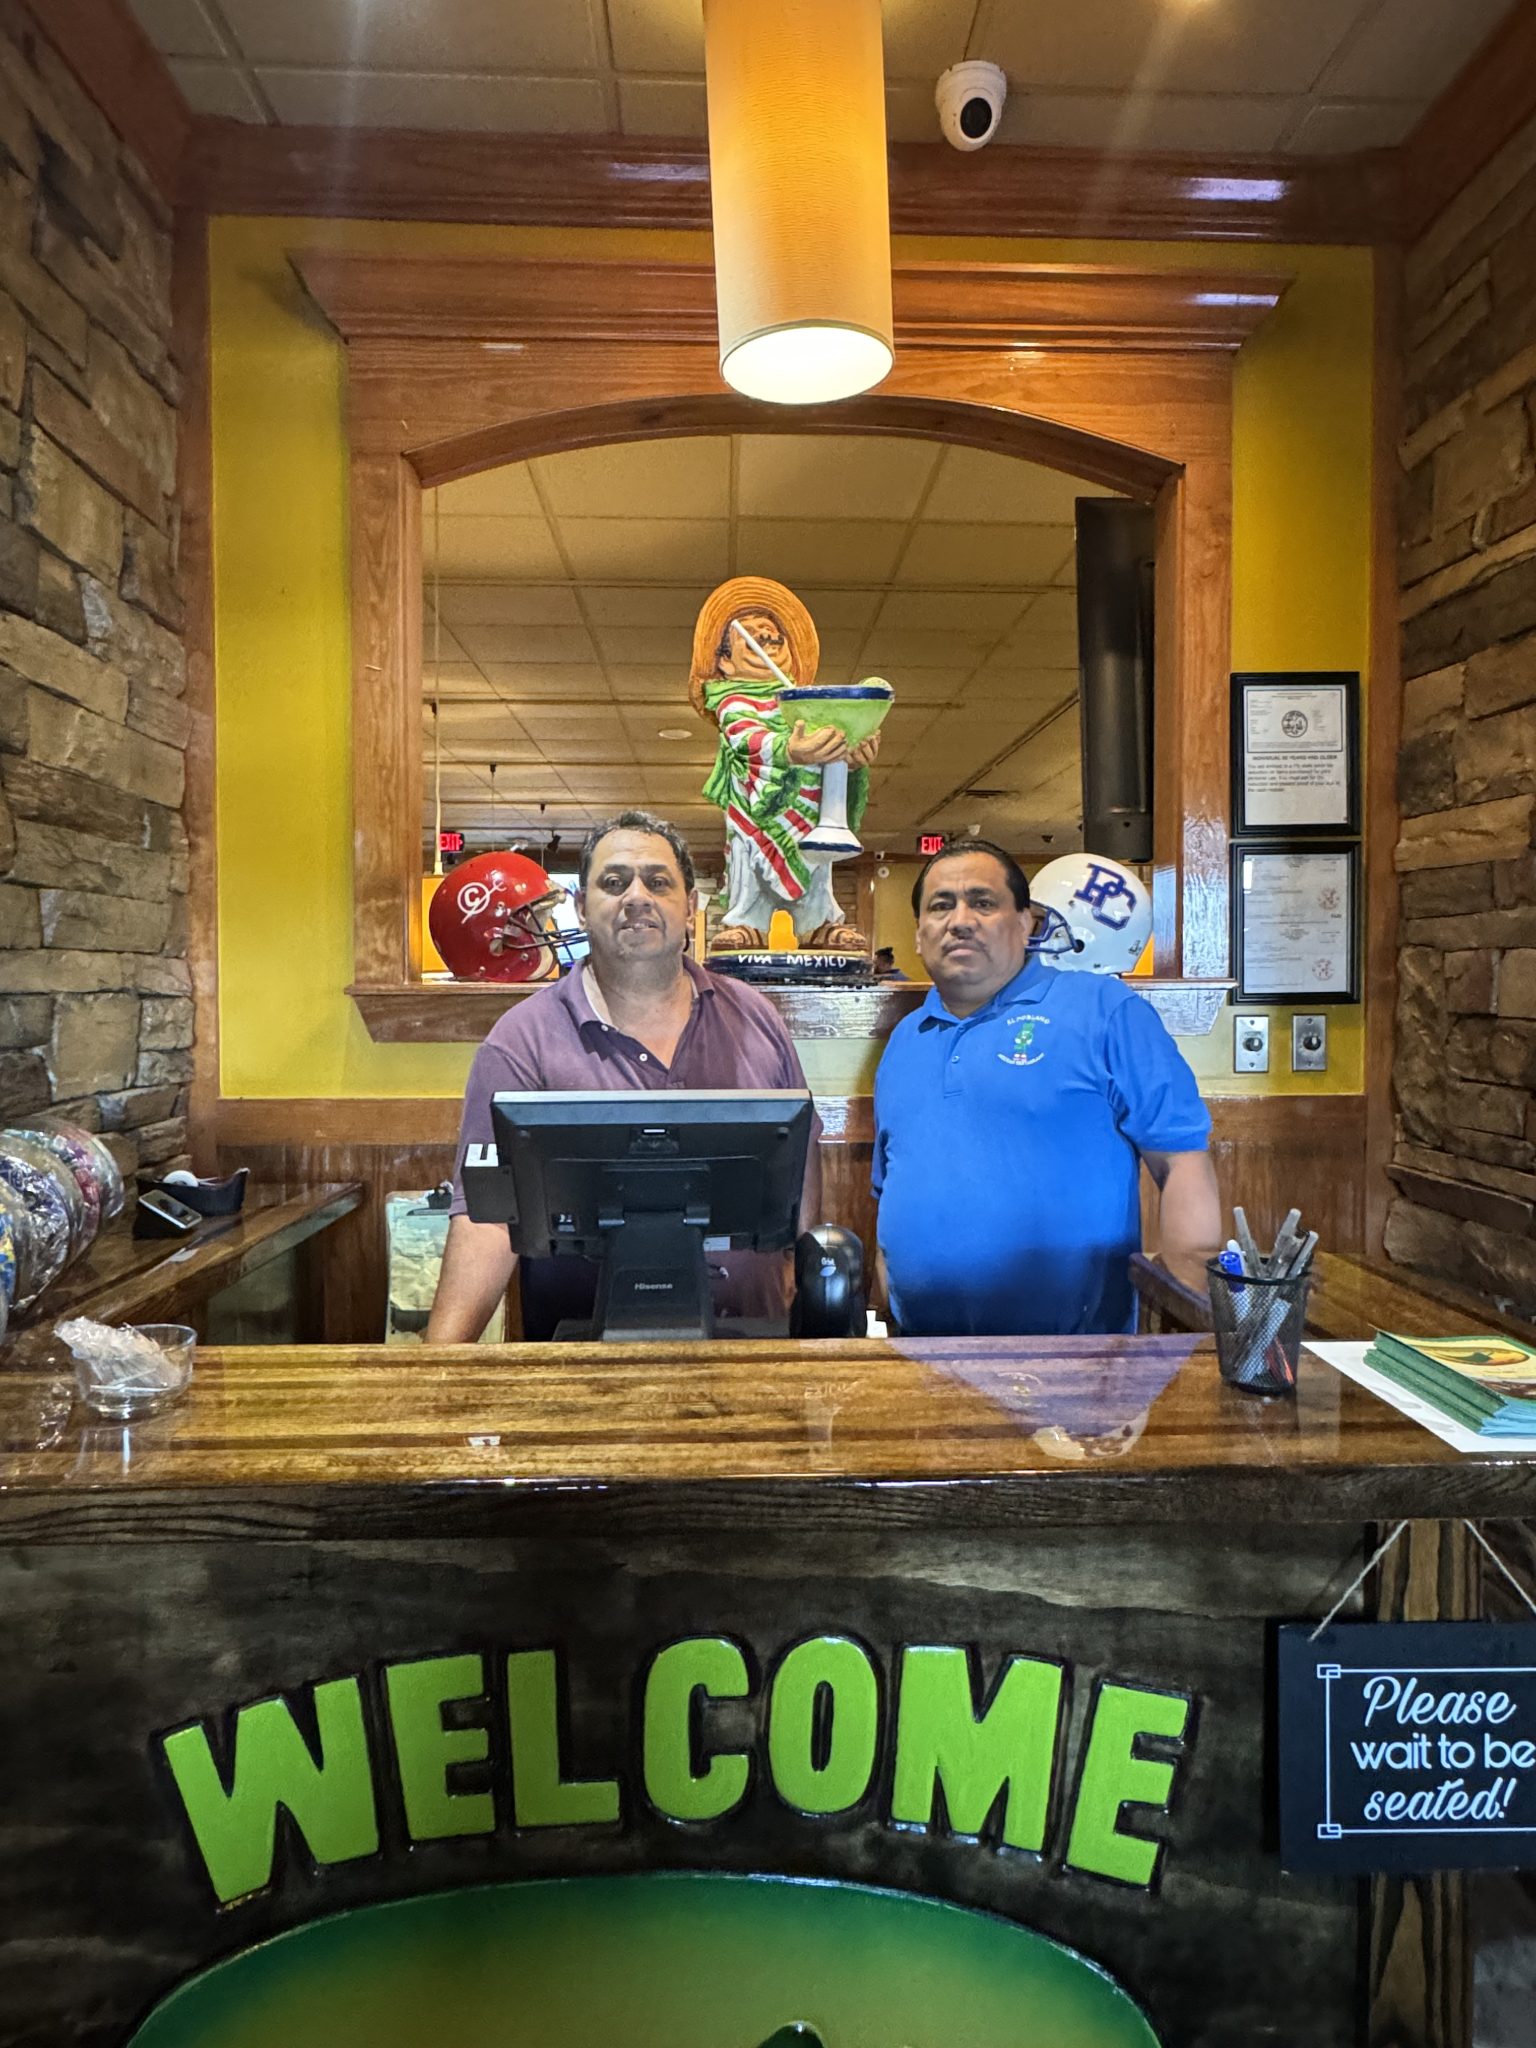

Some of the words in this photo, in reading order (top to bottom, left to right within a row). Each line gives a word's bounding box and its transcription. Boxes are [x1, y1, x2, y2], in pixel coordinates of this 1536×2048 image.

[439, 833, 460, 851] EXIT
[921, 836, 943, 855] EXIT
[1074, 863, 1137, 931] PC
[737, 954, 773, 964] VIVA
[786, 954, 847, 968] MEXICO
[1362, 1675, 1518, 1728] Please
[160, 1634, 1192, 1908] WELCOME
[1350, 1732, 1433, 1770] wait
[1437, 1733, 1476, 1770] to
[1483, 1732, 1536, 1769] be
[1363, 1776, 1518, 1822] seated!
